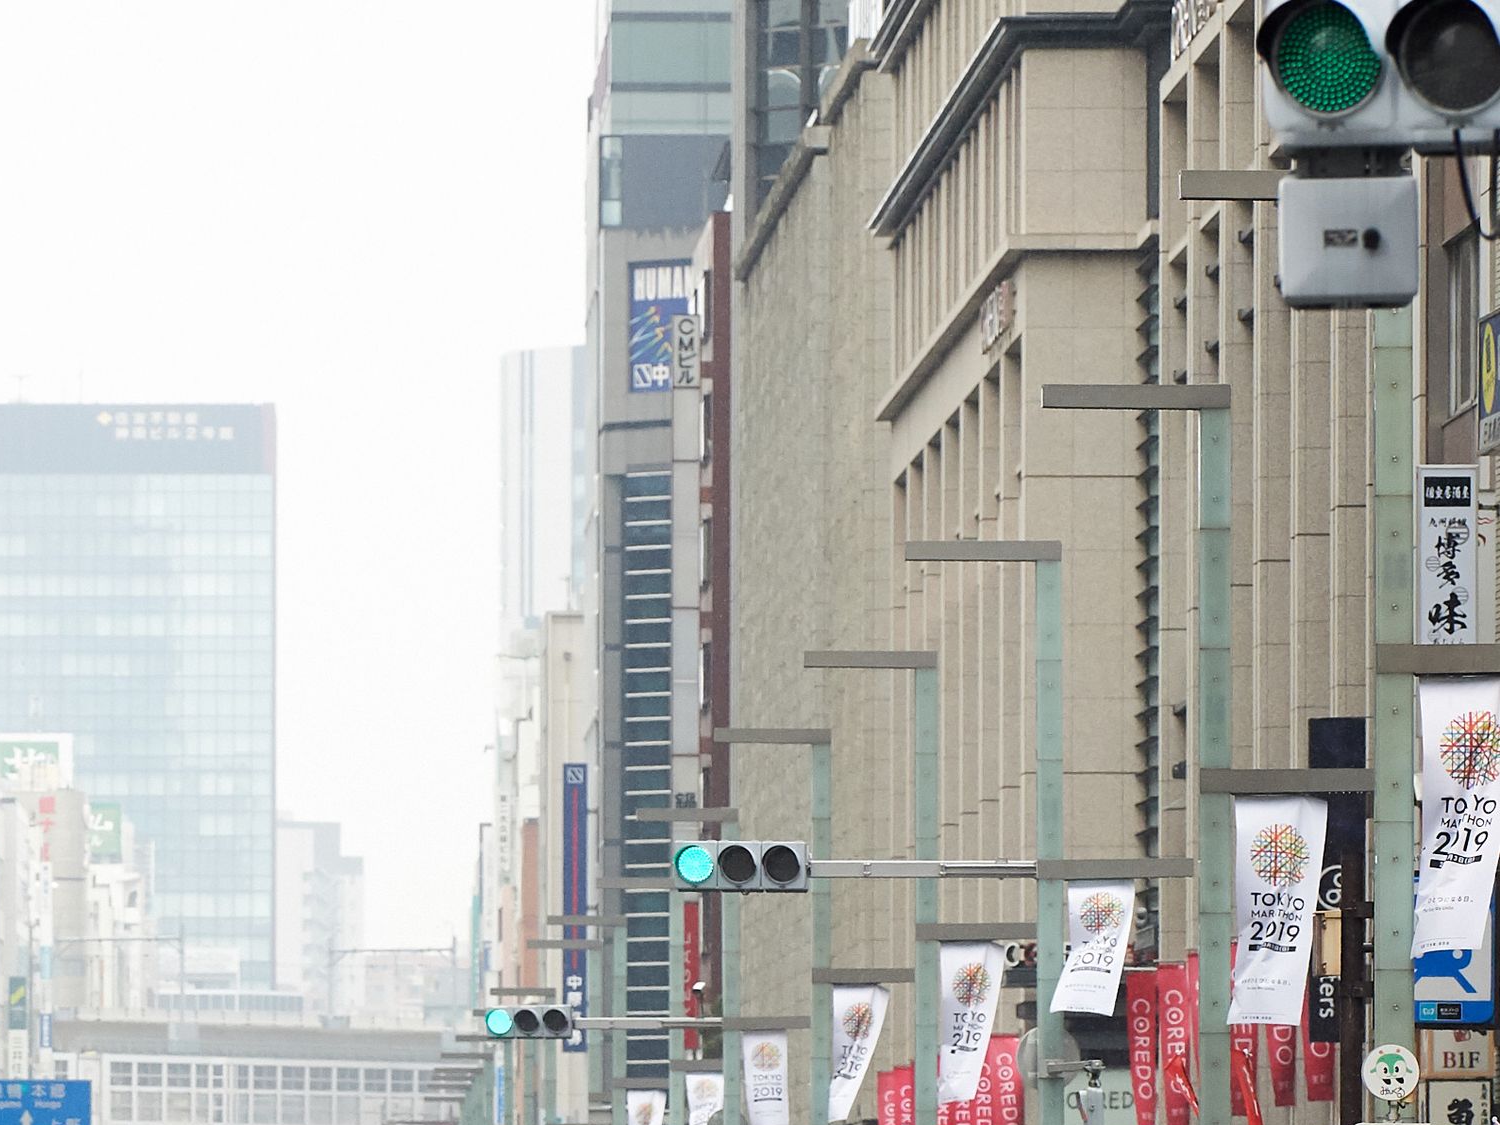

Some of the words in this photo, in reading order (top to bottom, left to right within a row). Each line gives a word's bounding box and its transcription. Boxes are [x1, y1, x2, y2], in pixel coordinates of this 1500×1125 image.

[678, 318, 697, 385] CMビル
[1441, 794, 1497, 815] TOYO
[1250, 892, 1305, 911] TOKYO
[1251, 909, 1302, 922] MARTHON
[1250, 921, 1301, 943] 2019
[1073, 952, 1114, 968] 2019
[953, 1012, 987, 1023] TOYO
[1131, 998, 1153, 1100] COREDO
[1443, 1051, 1481, 1069] B1F
[753, 1074, 783, 1082] TOKYO
[31, 1083, 66, 1099] 本郷
[753, 1087, 783, 1098] 2019
